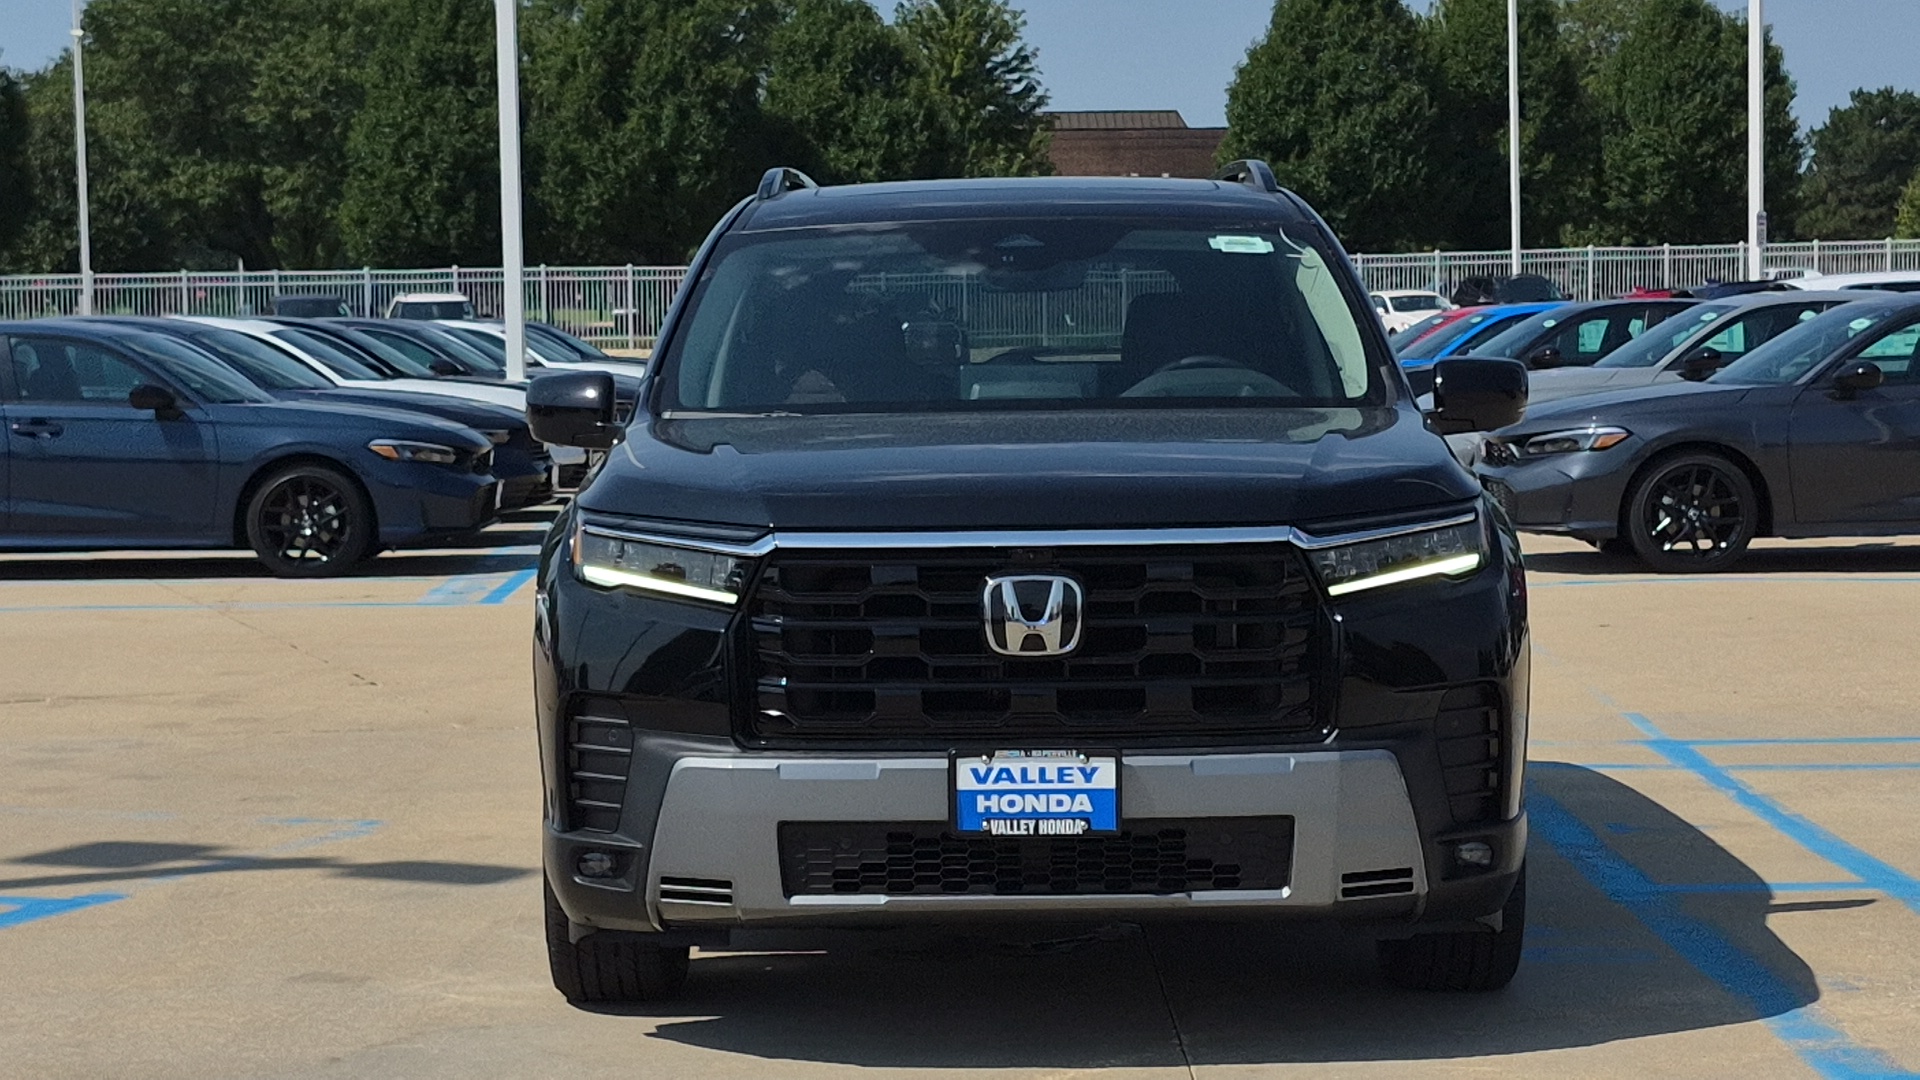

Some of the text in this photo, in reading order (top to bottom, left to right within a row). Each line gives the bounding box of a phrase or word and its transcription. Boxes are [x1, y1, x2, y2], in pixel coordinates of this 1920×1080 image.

[970, 767, 1100, 785] VALLEY
[977, 794, 1093, 813] HONDA
[990, 819, 1083, 835] VALLEY HONDA
